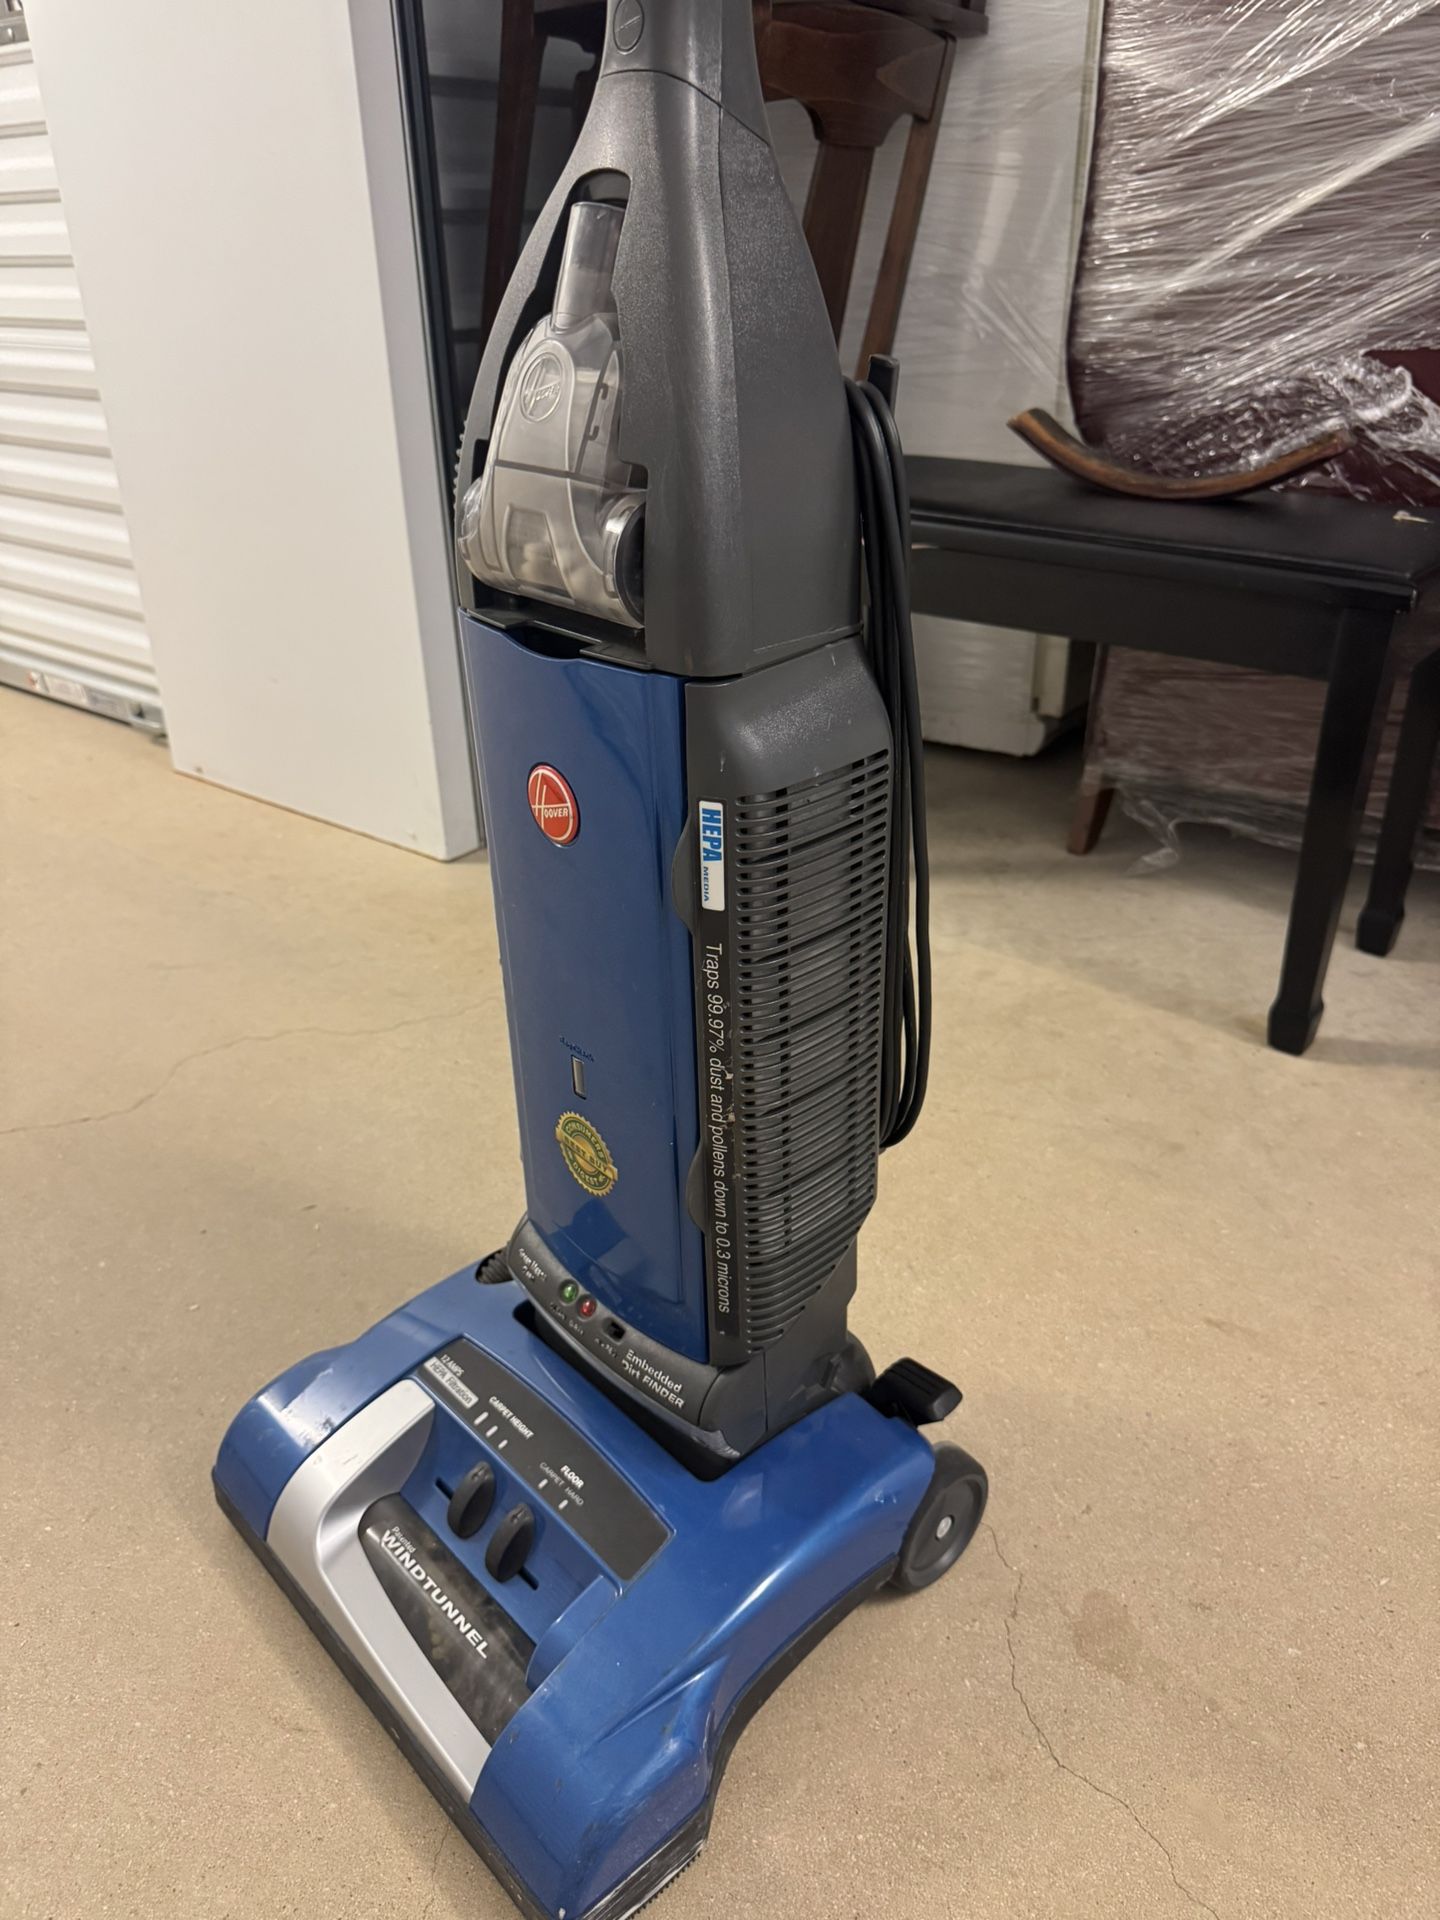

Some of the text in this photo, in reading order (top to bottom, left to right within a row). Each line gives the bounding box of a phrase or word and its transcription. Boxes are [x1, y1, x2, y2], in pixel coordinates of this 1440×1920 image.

[701, 808, 722, 862] HEPA
[703, 943, 733, 1314] Traps 99.97% dust and pollens down to 0.3 microns
[621, 1359, 685, 1409] Dirt FINDER
[626, 1349, 683, 1393] Embedded
[489, 1396, 534, 1440] CARPET HEIGHT
[540, 1462, 565, 1486] CARPET
[560, 1464, 585, 1490] FLOOR
[380, 1528, 489, 1660] WINDTUNNEL
